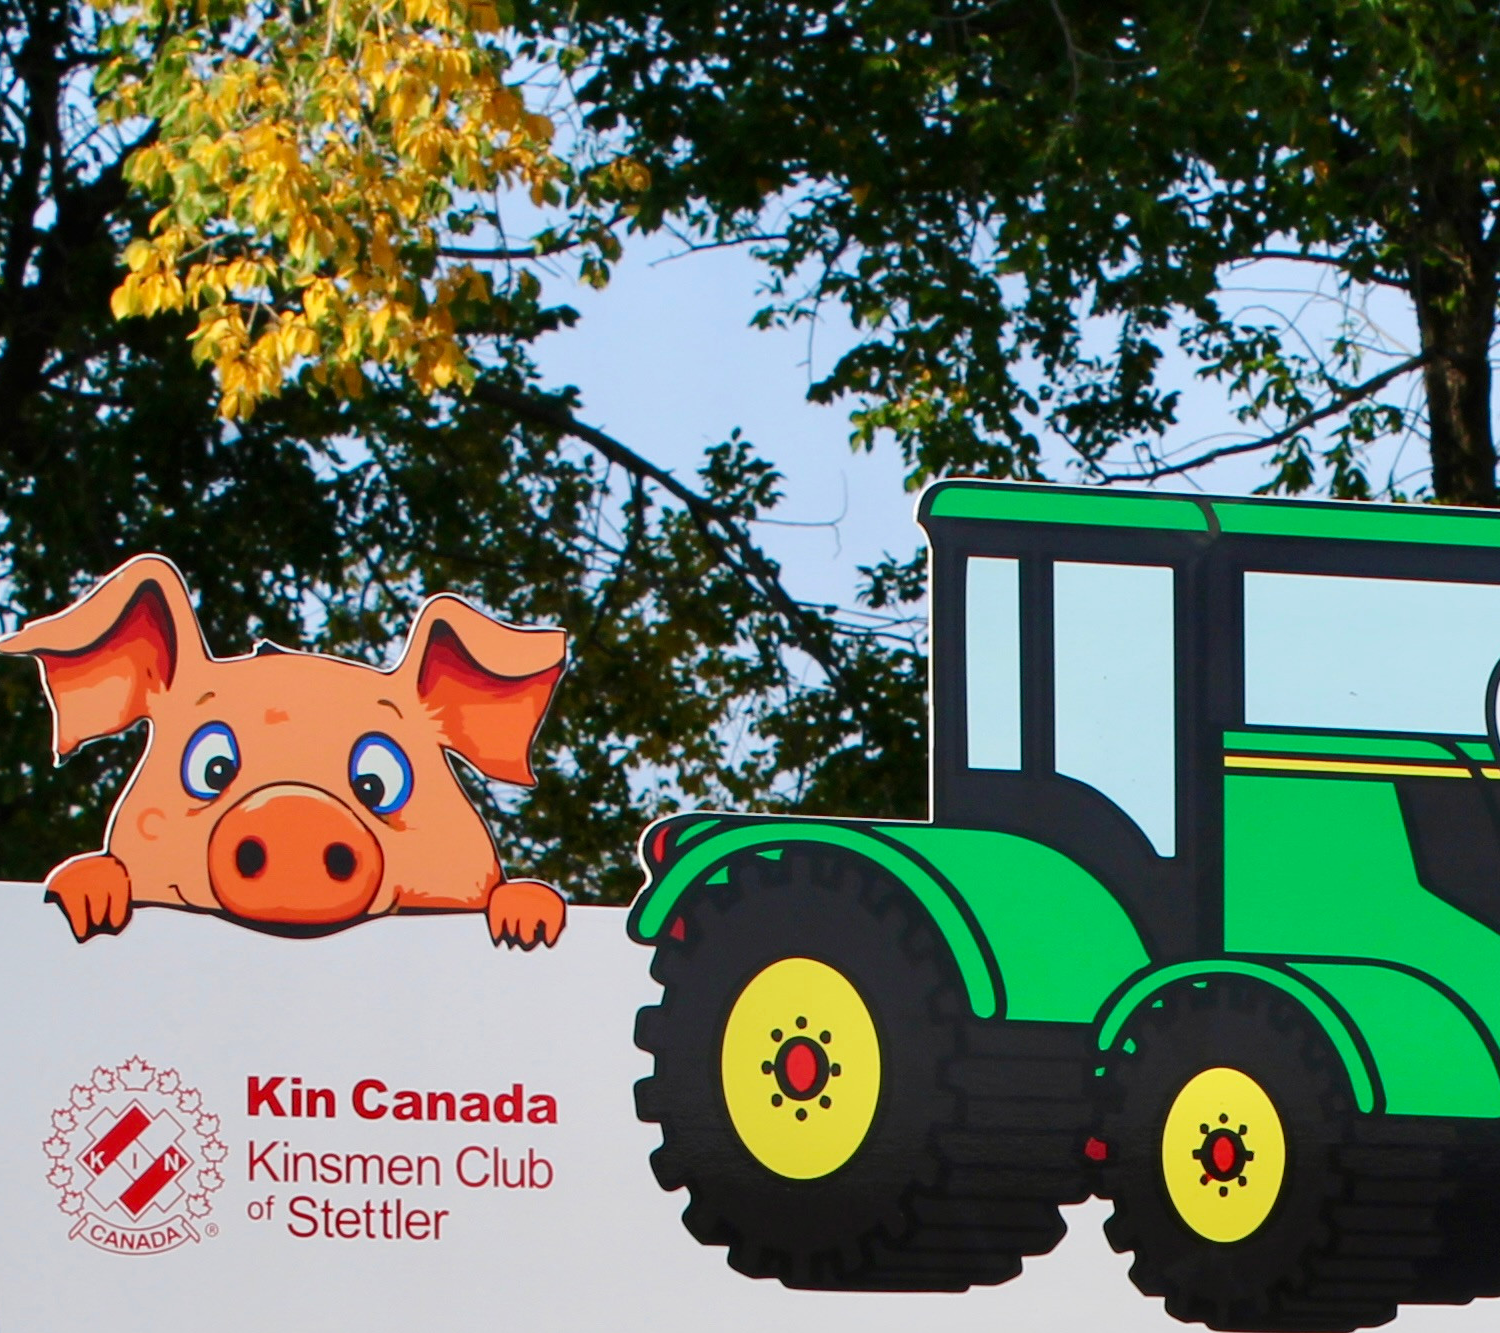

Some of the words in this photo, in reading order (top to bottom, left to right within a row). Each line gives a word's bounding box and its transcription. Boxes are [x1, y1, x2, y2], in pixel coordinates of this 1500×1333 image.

[248, 1076, 335, 1118] Kin
[352, 1079, 557, 1124] Canada
[249, 1141, 440, 1186] Kinsmen
[456, 1146, 553, 1189] Club
[90, 1225, 182, 1250] CANADA
[248, 1195, 275, 1220] of
[288, 1196, 449, 1240] Stettler
